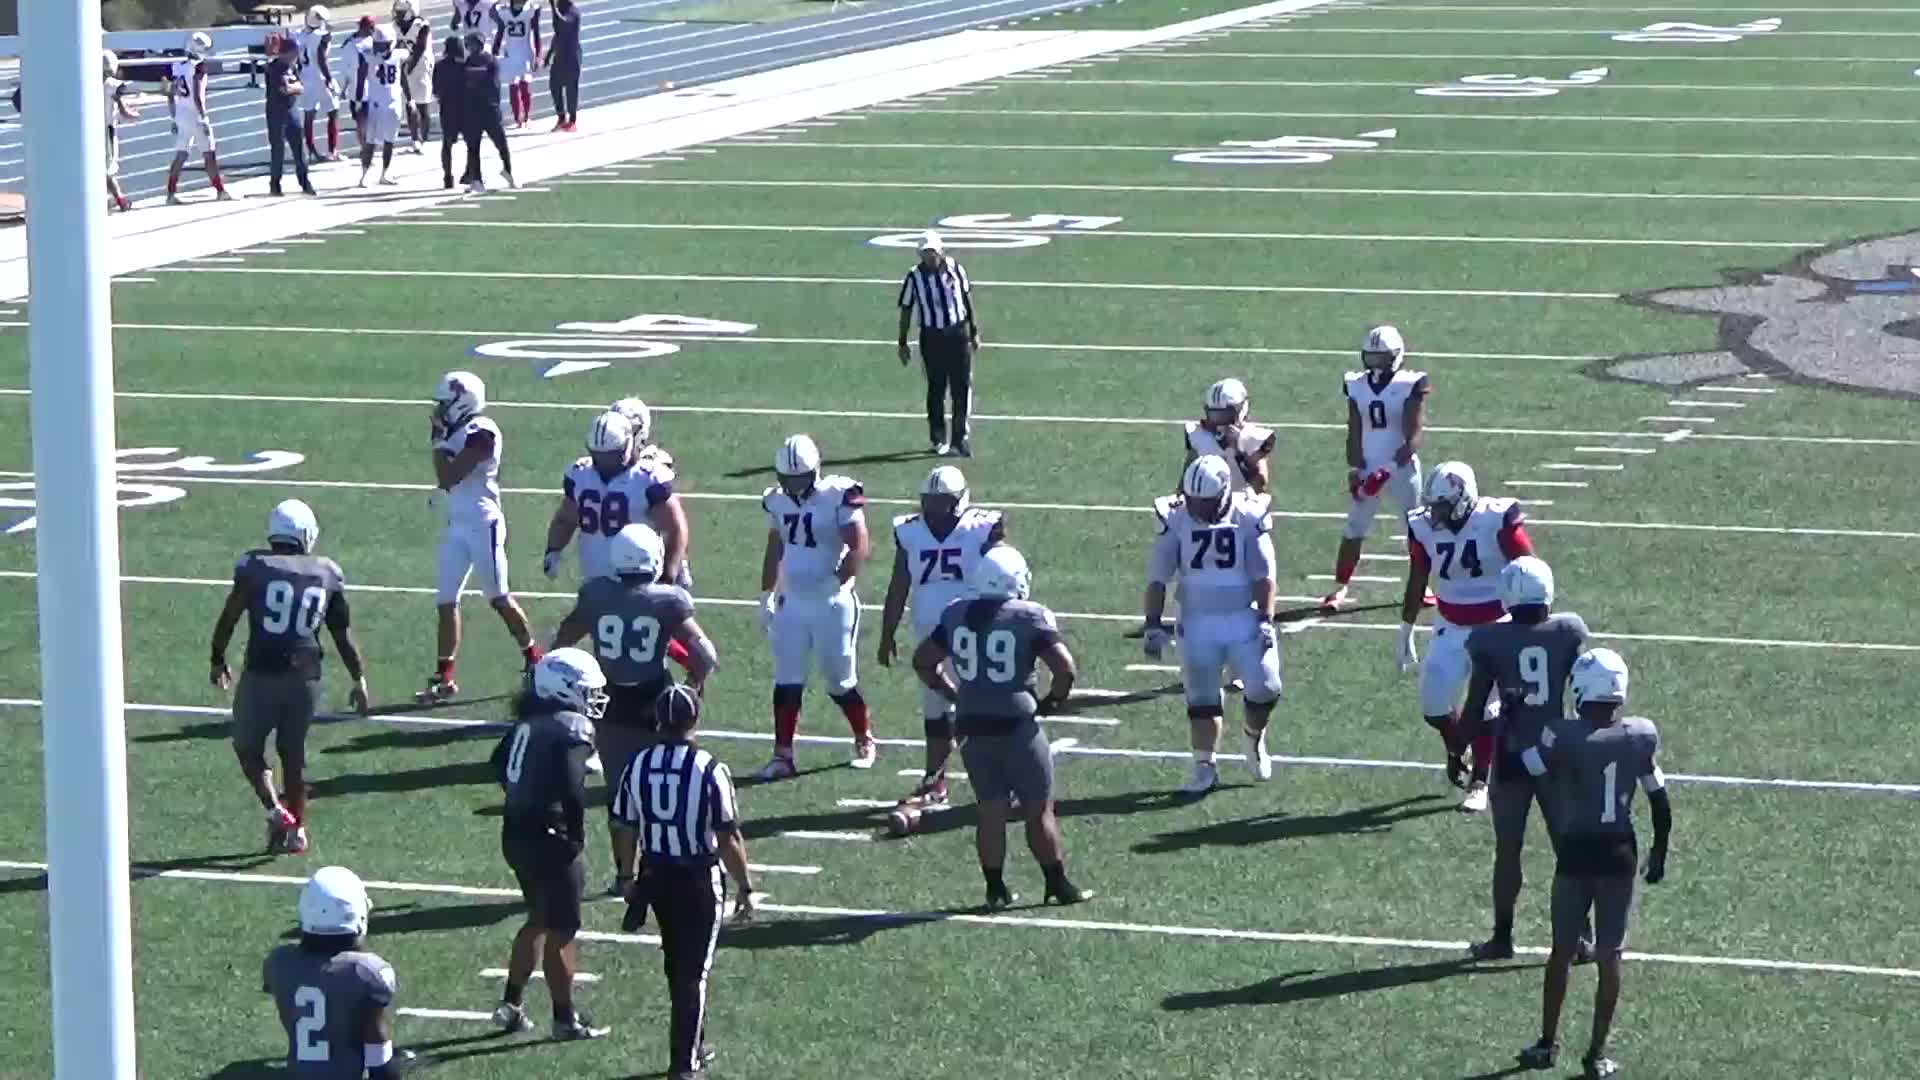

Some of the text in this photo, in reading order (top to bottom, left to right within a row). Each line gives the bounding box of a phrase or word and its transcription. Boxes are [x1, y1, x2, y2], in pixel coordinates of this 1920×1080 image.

[508, 21, 526, 37] 23
[1414, 73, 1604, 96] 30
[1172, 136, 1379, 163] 40
[868, 214, 1123, 248] 50
[474, 314, 758, 359] 40
[1368, 400, 1386, 428] 0
[577, 489, 628, 537] 68
[783, 512, 816, 547] 71
[919, 548, 963, 585] 75
[1190, 528, 1235, 569] 79
[1435, 539, 1483, 580] 74
[263, 580, 326, 638] 90
[598, 614, 661, 663] 93
[952, 625, 1016, 682] 99
[1518, 645, 1549, 705] 9
[506, 723, 531, 784] 0
[648, 771, 681, 820] U
[1600, 761, 1617, 823] 1
[295, 986, 330, 1061] 2
